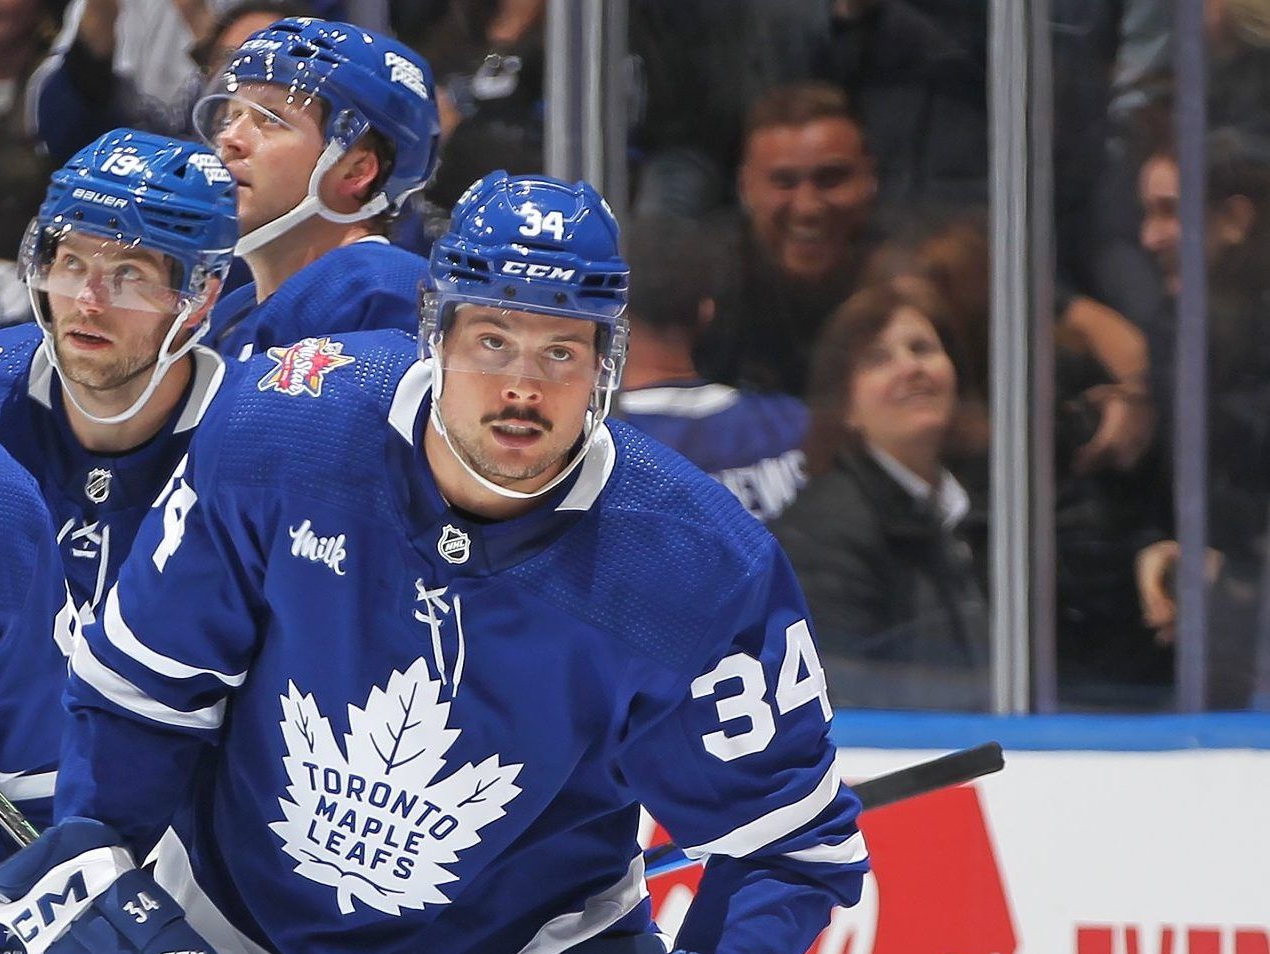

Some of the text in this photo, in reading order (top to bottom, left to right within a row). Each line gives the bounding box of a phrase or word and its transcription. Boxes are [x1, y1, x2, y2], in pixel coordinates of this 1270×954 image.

[72, 188, 129, 208] BAUER
[518, 206, 566, 241] 34
[501, 260, 577, 281] CCM
[289, 519, 347, 576] Milk
[445, 540, 466, 552] NHL
[690, 618, 835, 763] 34
[302, 761, 459, 841] TORONTO
[314, 794, 425, 856] MAPLE
[306, 818, 415, 880] LEAFS
[122, 891, 161, 924] 34
